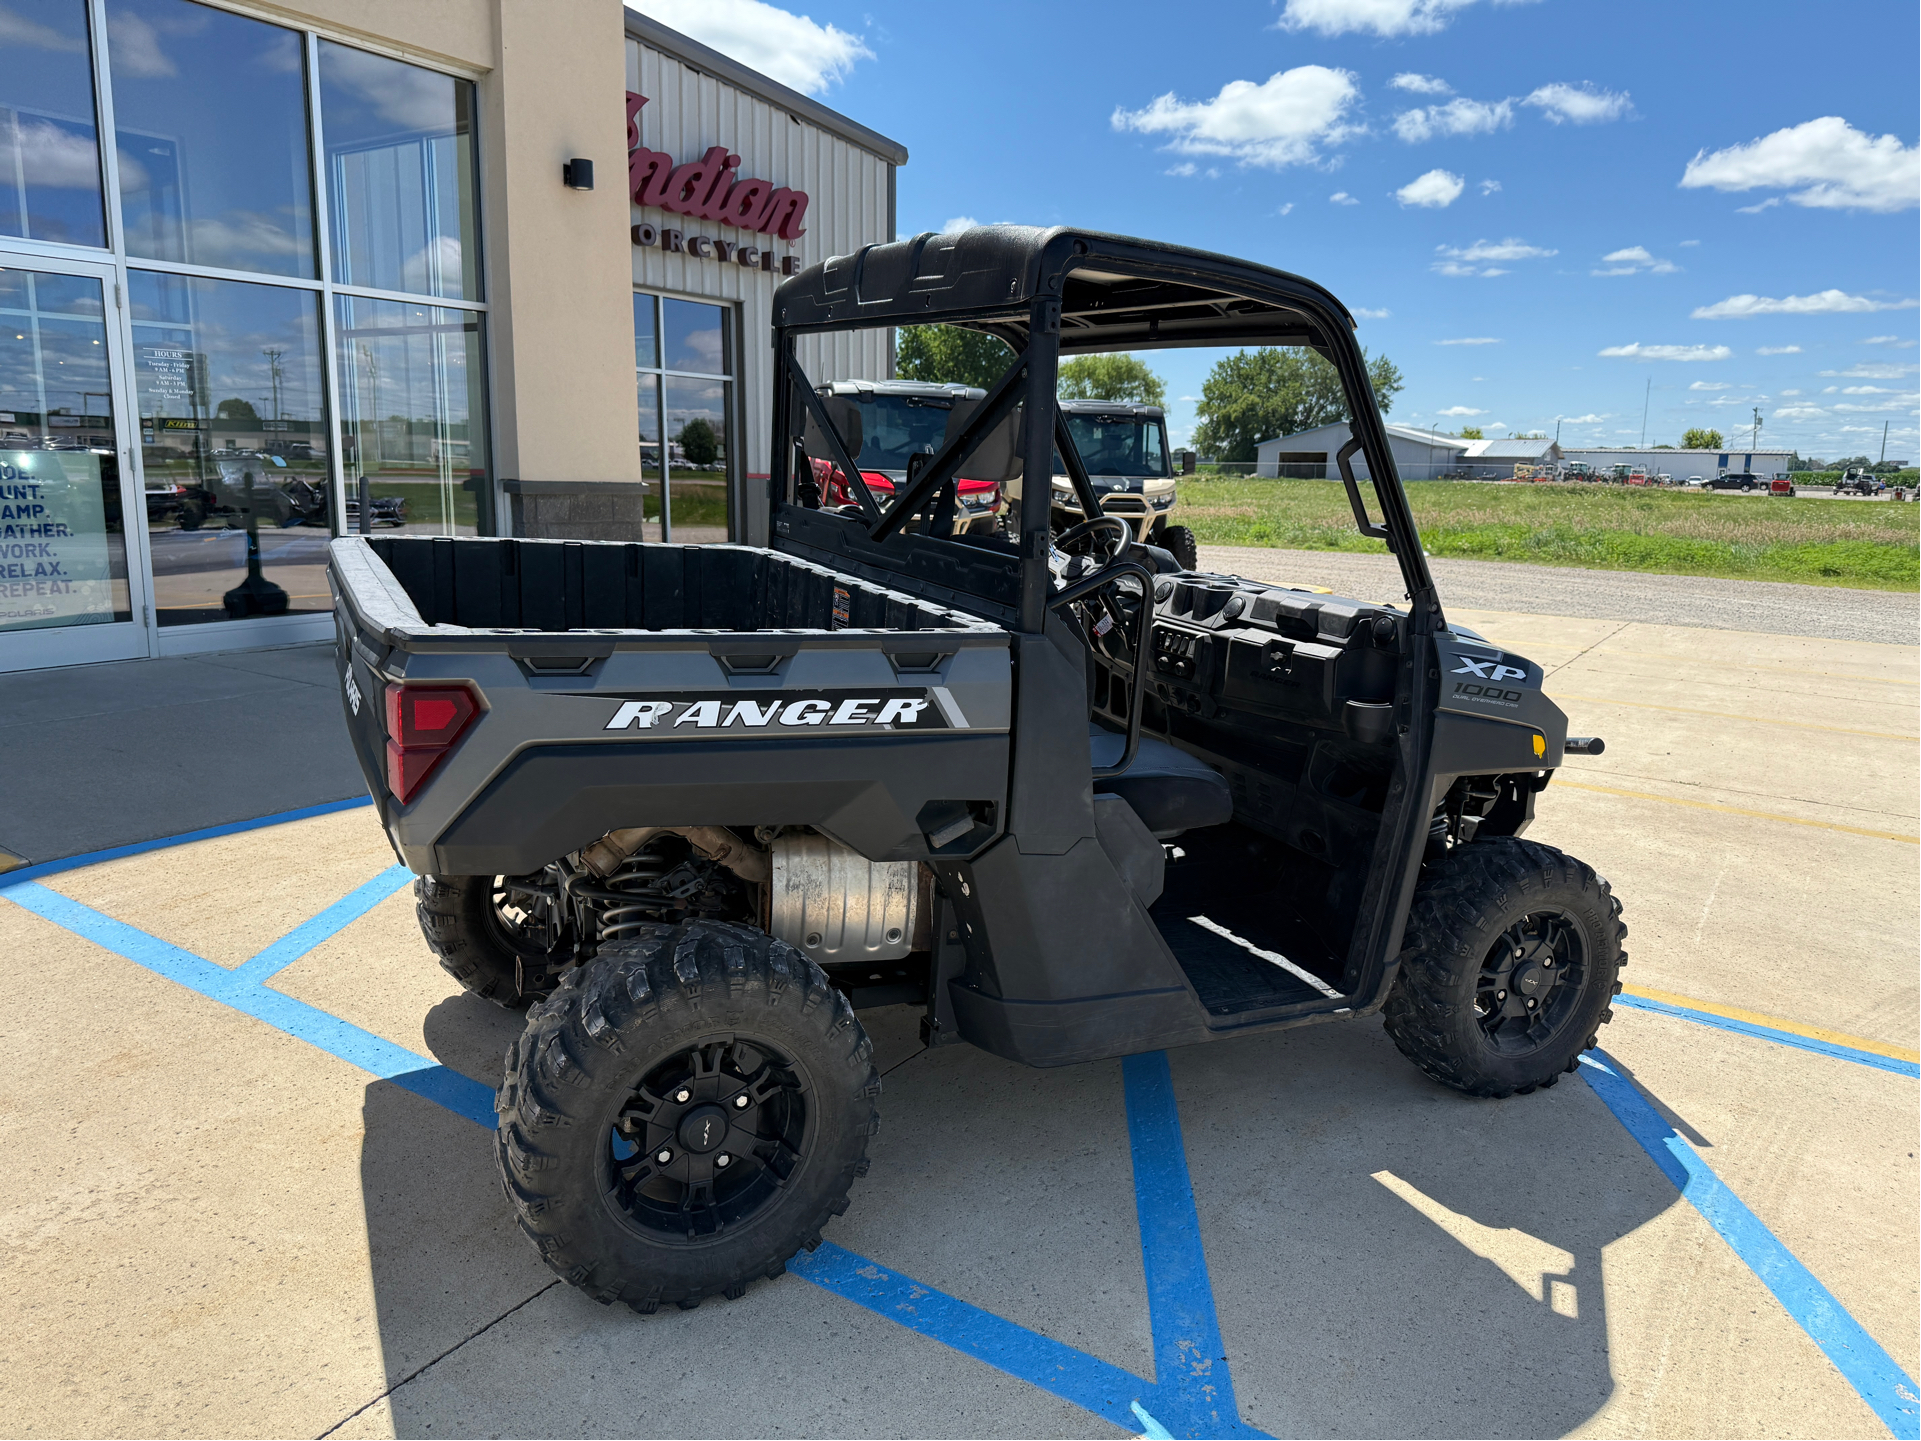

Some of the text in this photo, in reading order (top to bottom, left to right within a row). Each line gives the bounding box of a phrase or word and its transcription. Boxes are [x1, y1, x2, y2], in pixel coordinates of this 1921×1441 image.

[631, 223, 801, 275] ORCYCLE
[0, 579, 77, 598] REPEAT.
[0, 608, 54, 618] POLARIS
[1451, 656, 1526, 681] XP
[1454, 682, 1522, 702] 1000
[1471, 697, 1505, 706] OVERHEAD
[603, 697, 929, 730] RANGER
